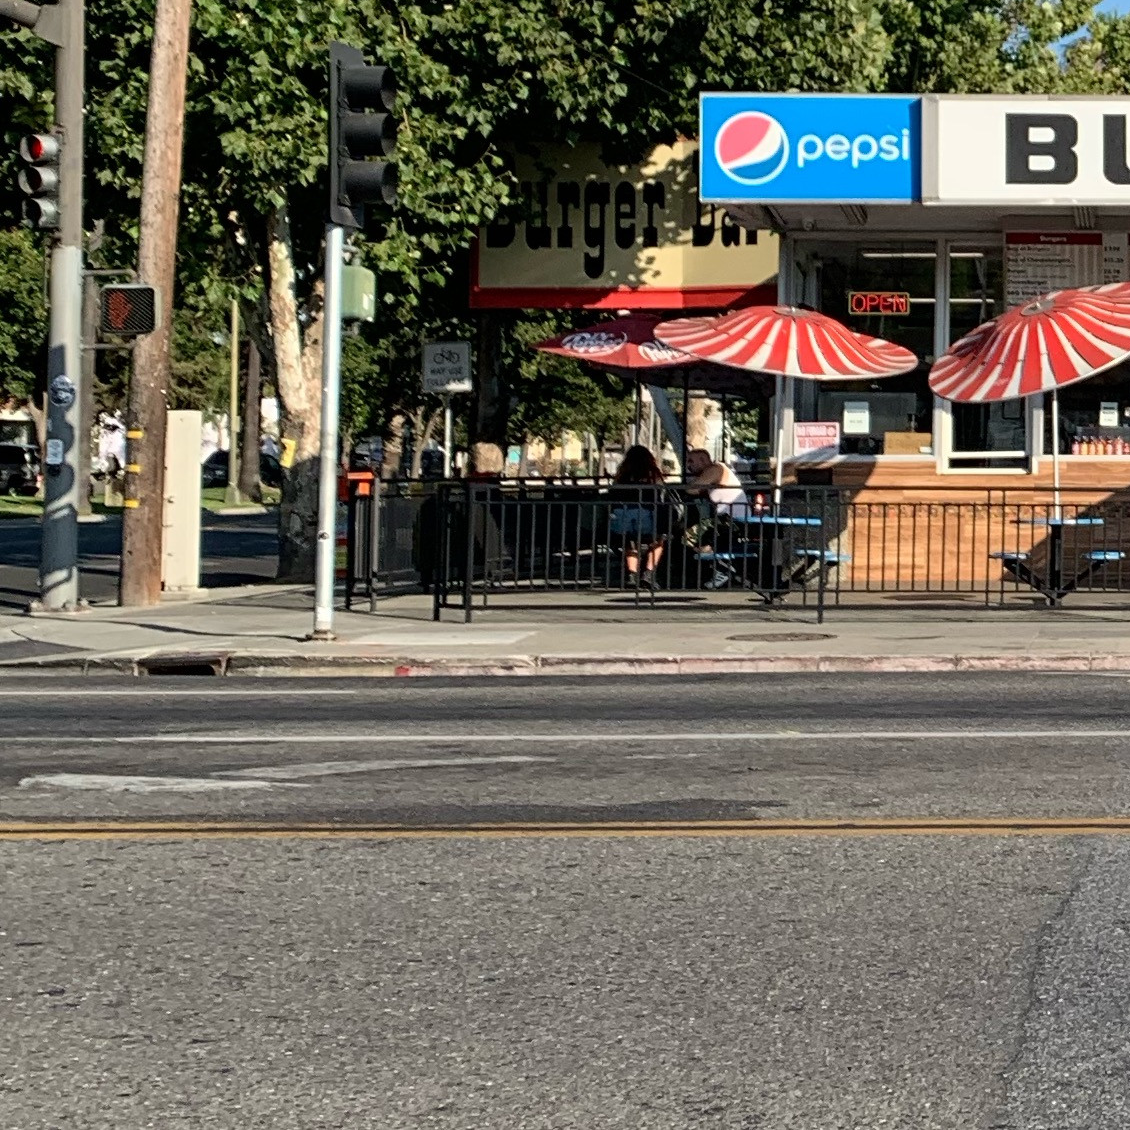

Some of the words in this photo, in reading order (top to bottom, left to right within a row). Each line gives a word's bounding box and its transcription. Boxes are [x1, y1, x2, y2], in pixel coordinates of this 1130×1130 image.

[796, 127, 910, 169] pepsi
[1039, 235, 1067, 243] Burgers
[851, 293, 907, 314] OPEN
